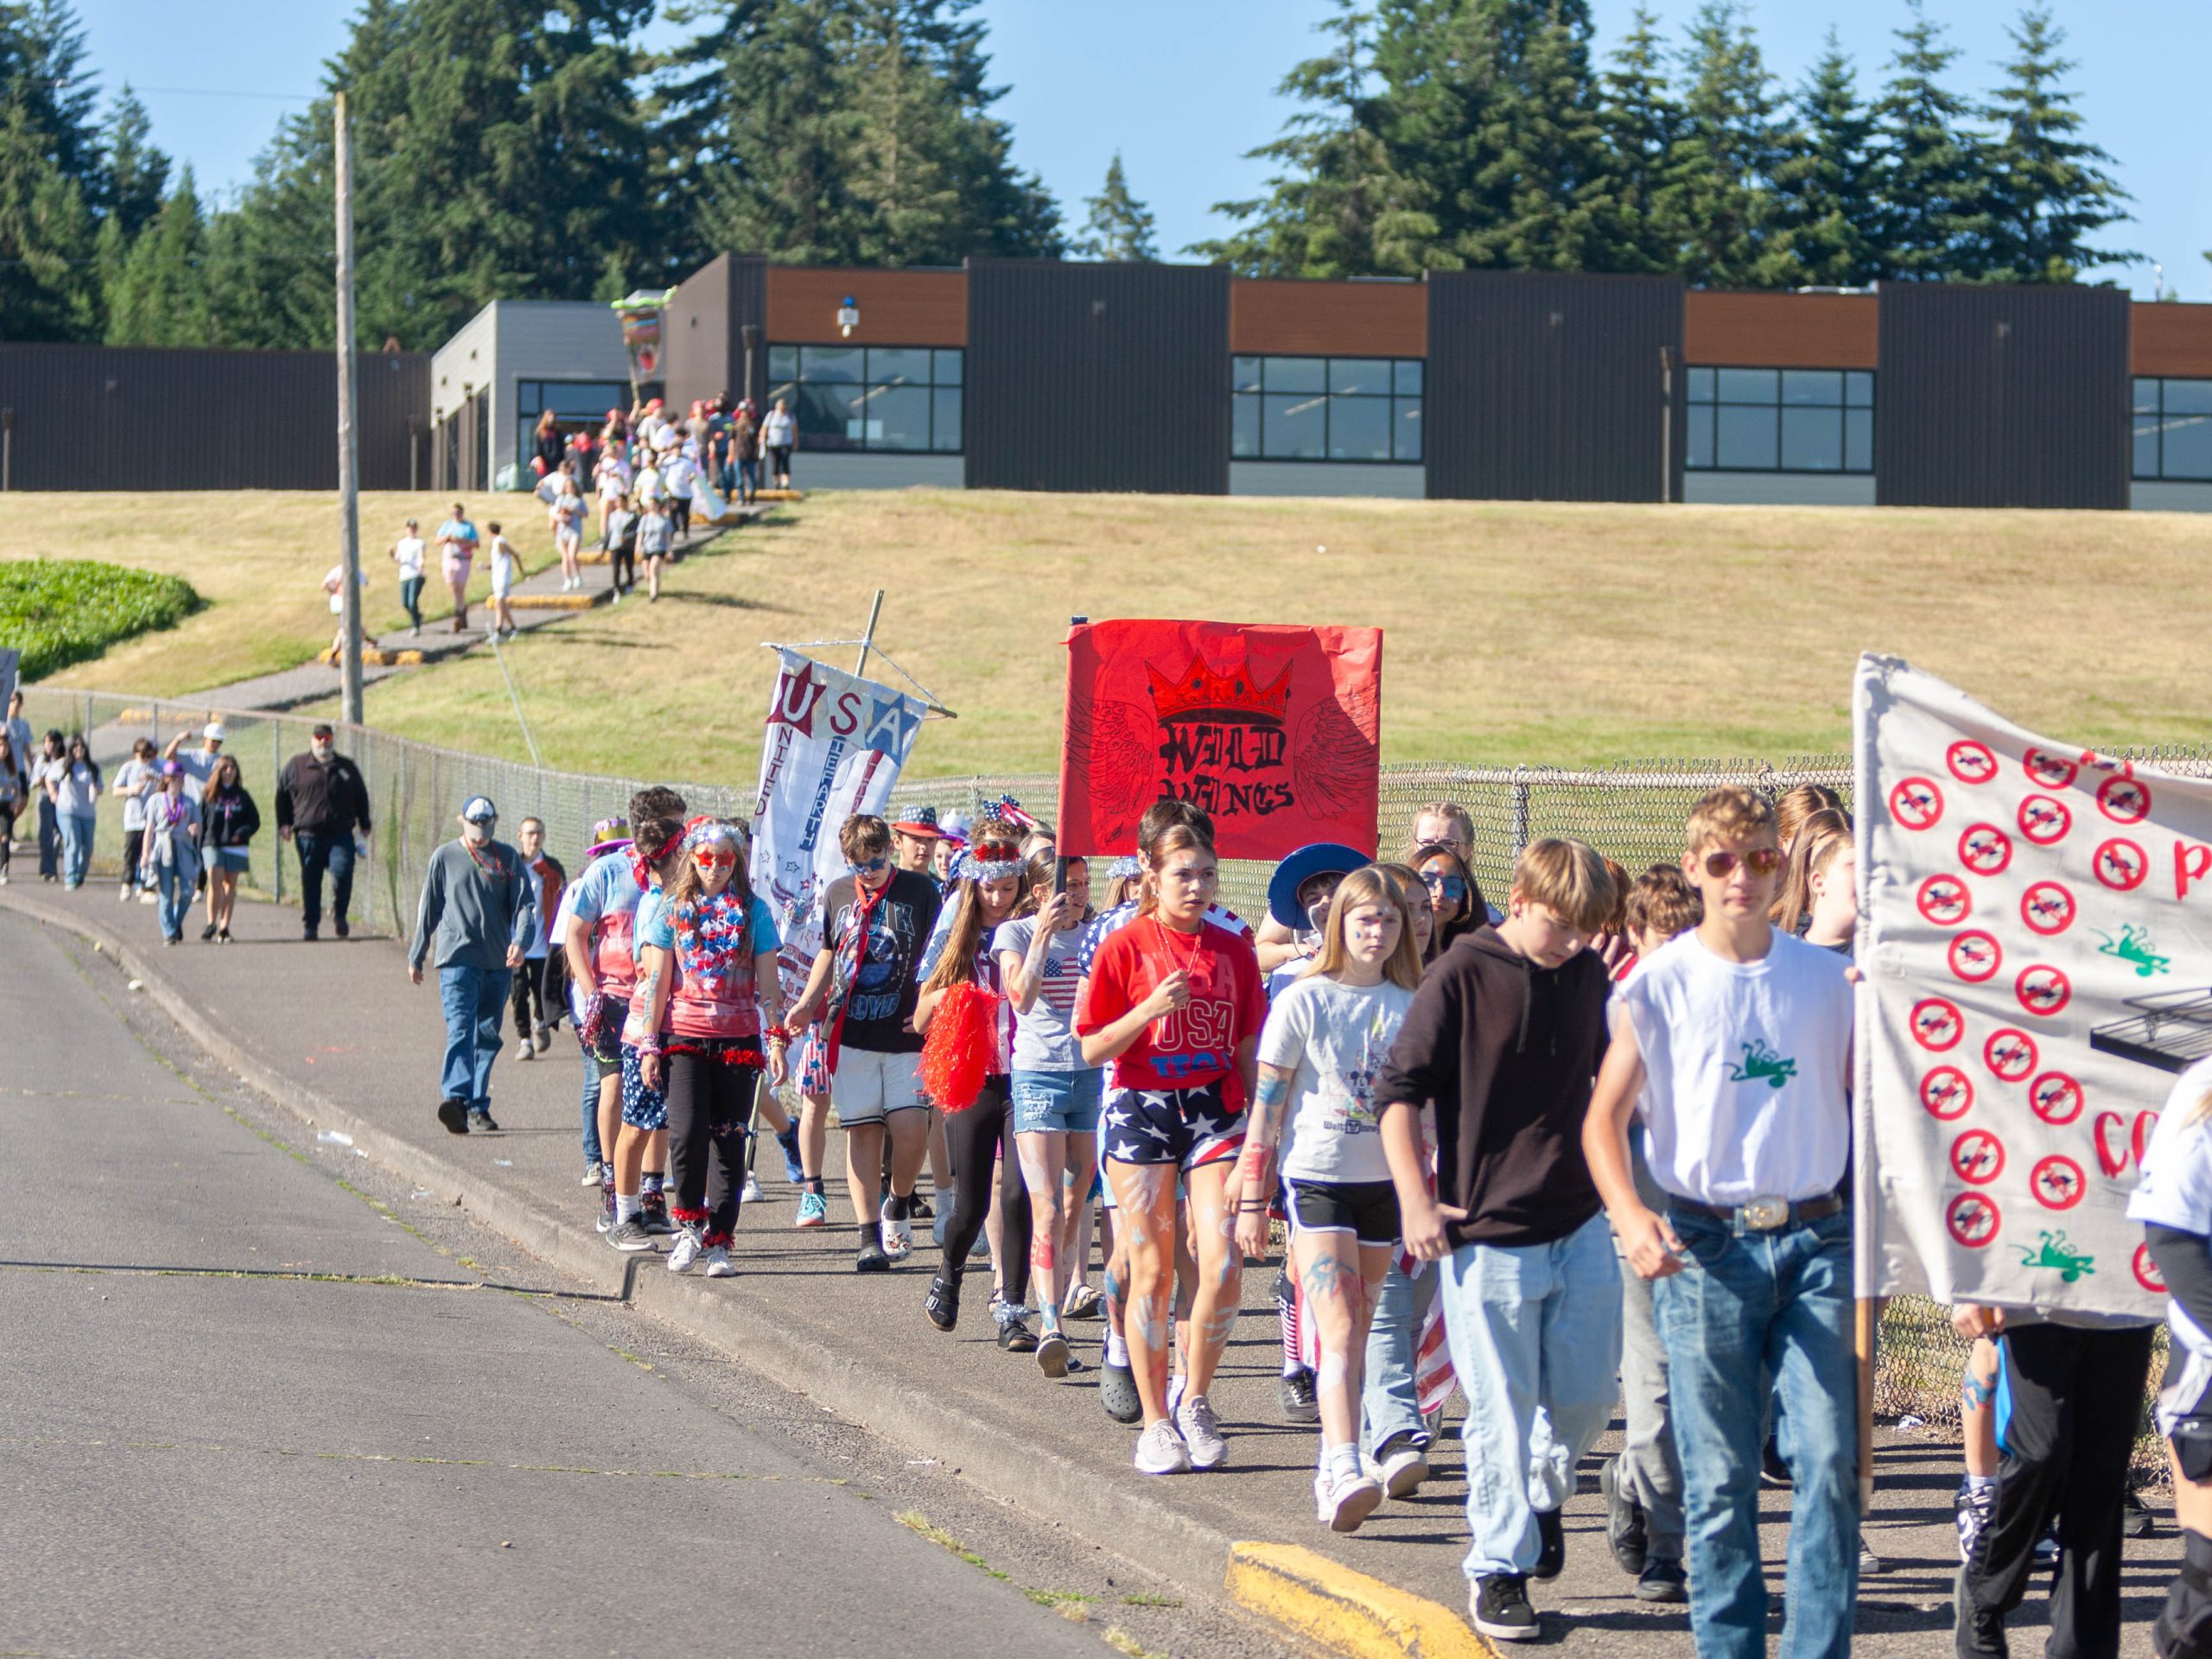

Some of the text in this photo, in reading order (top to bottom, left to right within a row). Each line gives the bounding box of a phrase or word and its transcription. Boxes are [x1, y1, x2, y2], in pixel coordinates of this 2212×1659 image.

[782, 677, 900, 755] USA
[1159, 723, 1287, 774] WILD
[1158, 775, 1294, 817] WINGS
